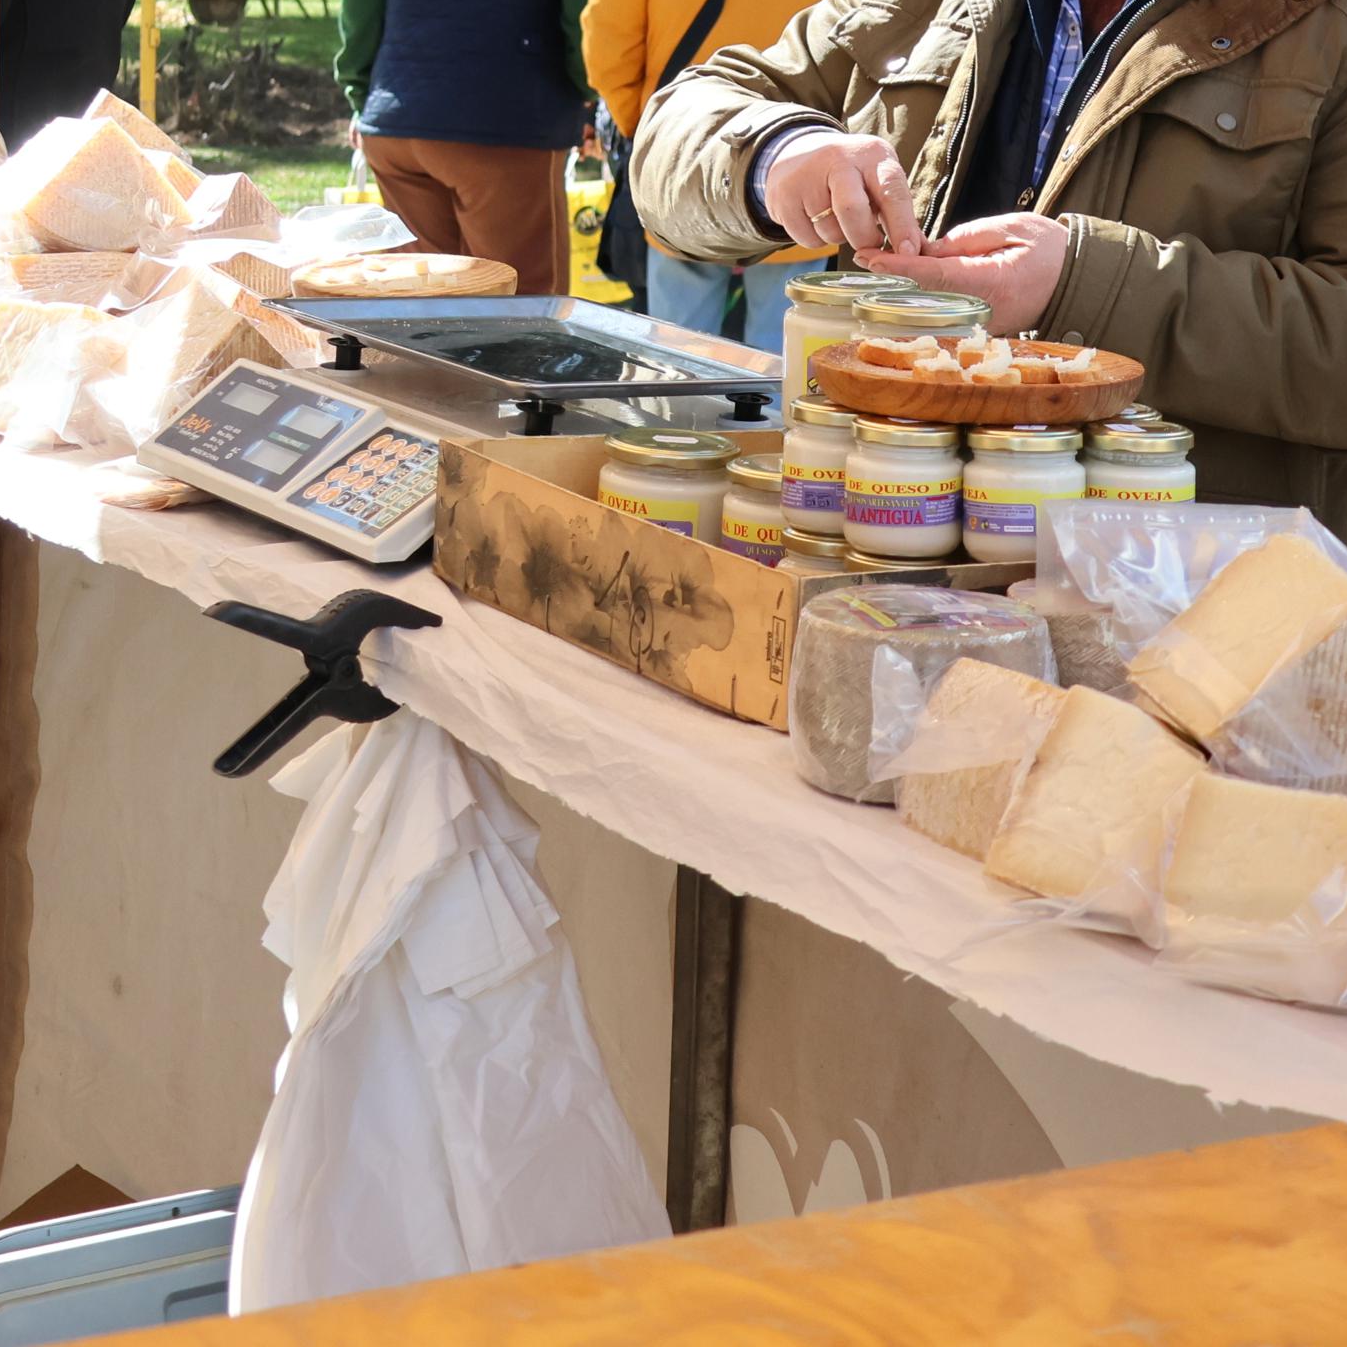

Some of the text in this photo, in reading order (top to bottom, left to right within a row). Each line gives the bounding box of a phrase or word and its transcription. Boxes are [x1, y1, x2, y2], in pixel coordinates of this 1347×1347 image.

[789, 466, 845, 480] DE OVE
[849, 481, 863, 492] DE
[871, 482, 930, 494] QUESO
[940, 480, 958, 492] DE
[1089, 487, 1173, 501] DE OVEJA
[608, 495, 648, 515] OVEJA
[859, 506, 925, 525] ANTIGUA
[734, 523, 749, 538] DE
[756, 528, 782, 543] QU
